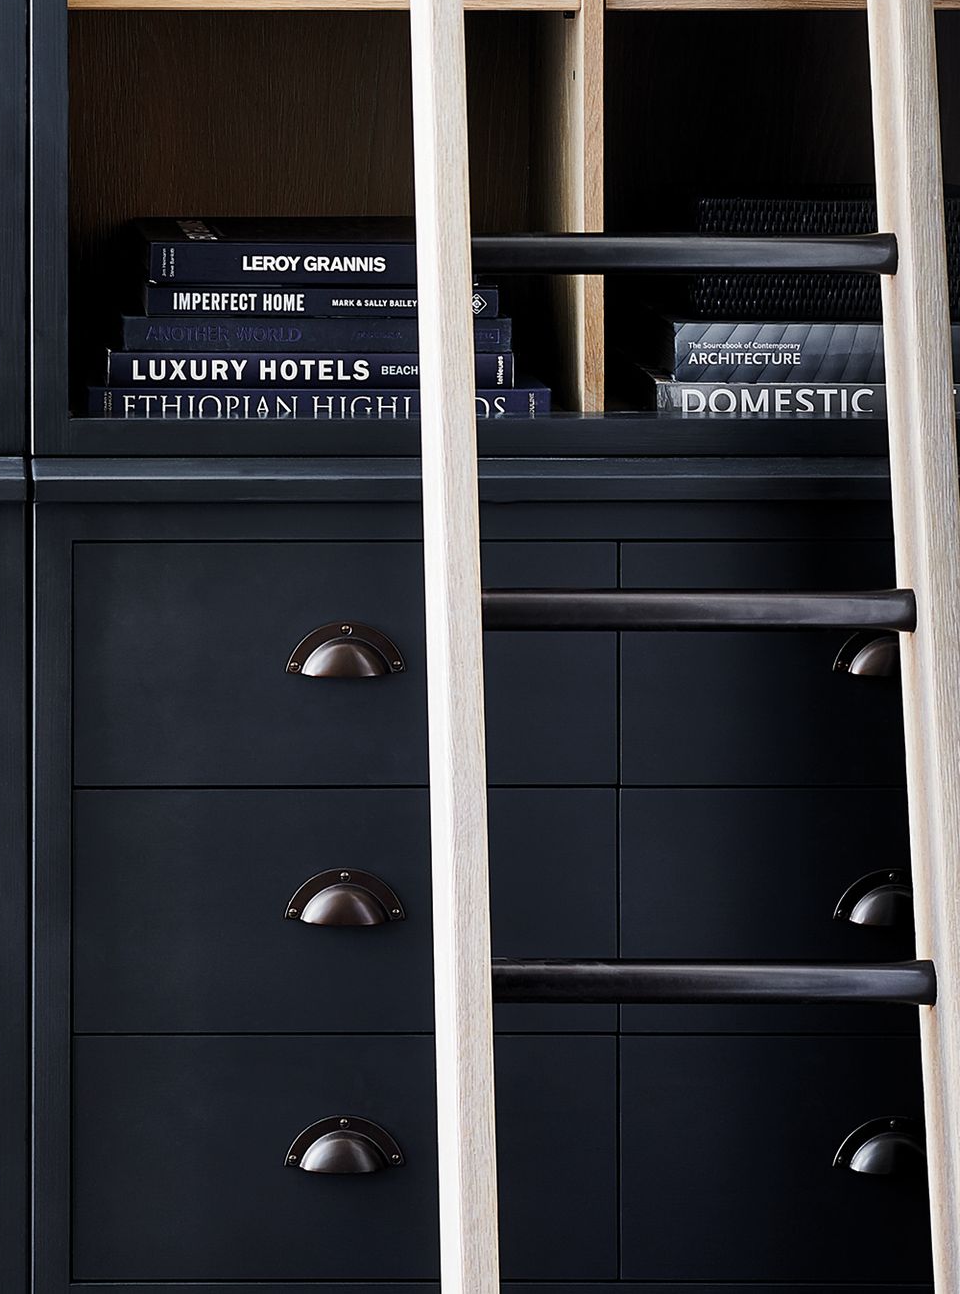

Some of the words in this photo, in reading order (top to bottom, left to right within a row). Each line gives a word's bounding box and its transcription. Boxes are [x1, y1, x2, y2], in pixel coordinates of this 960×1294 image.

[242, 256, 301, 271] LEROY
[303, 256, 386, 273] GRANNIS
[173, 292, 258, 311] IMPERFECT
[263, 293, 305, 312] HOME
[331, 299, 356, 307] MARK
[356, 299, 363, 307] &
[364, 299, 388, 307] SALLY
[389, 299, 418, 308] BAILEY
[145, 325, 230, 342] ANOTHER
[235, 326, 303, 343] WORLD
[688, 341, 701, 349] The
[702, 341, 743, 350] Sourcebook
[743, 341, 752, 349] of
[752, 341, 801, 351] Contemporary
[688, 352, 801, 366] ARCHITECTURE
[132, 359, 248, 381] LUXURY
[259, 359, 370, 381] HOTELS
